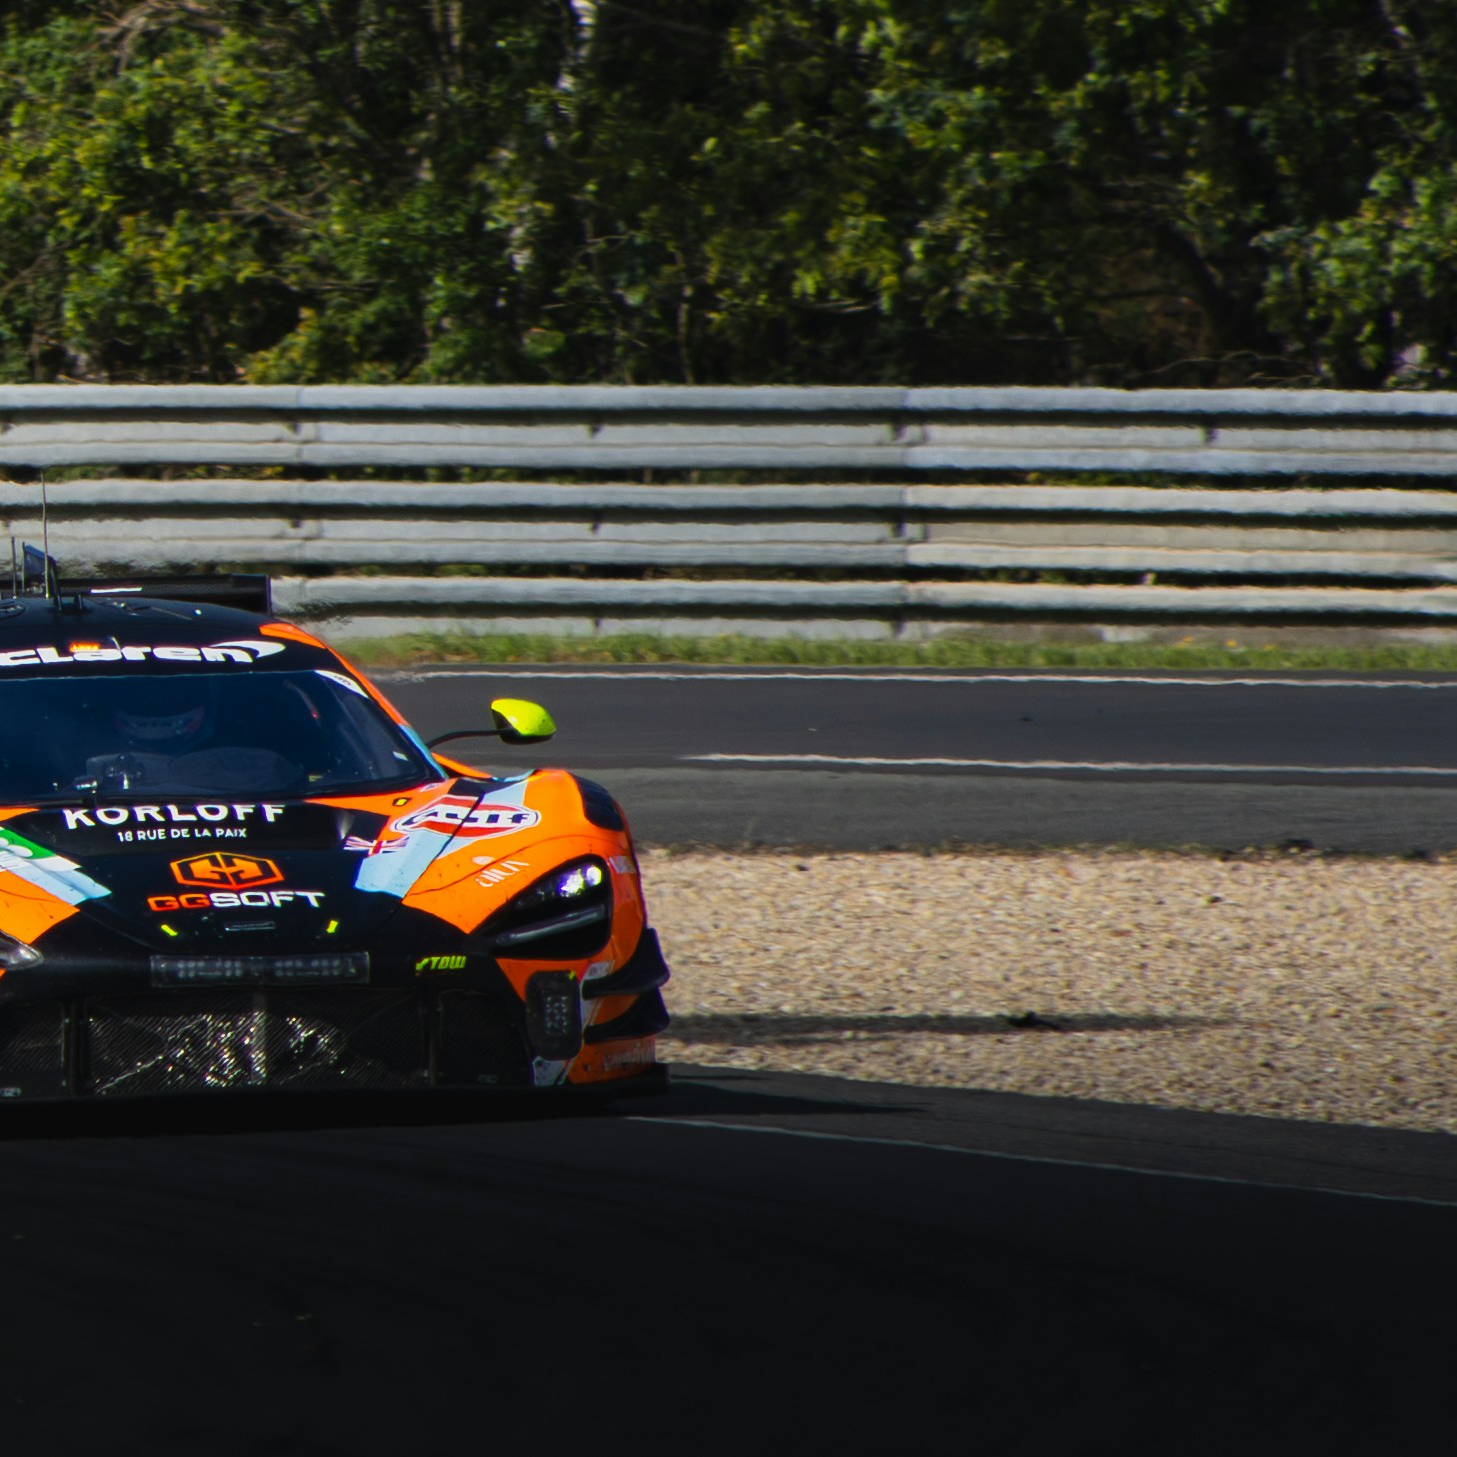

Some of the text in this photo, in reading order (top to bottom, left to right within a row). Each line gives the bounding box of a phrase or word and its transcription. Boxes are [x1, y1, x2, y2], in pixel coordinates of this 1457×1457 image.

[63, 805, 285, 830] KORLOFF
[118, 828, 247, 842] 18 RUE DE LA PAIX
[147, 891, 326, 913] GGSOFT
[430, 955, 467, 971] TOW
